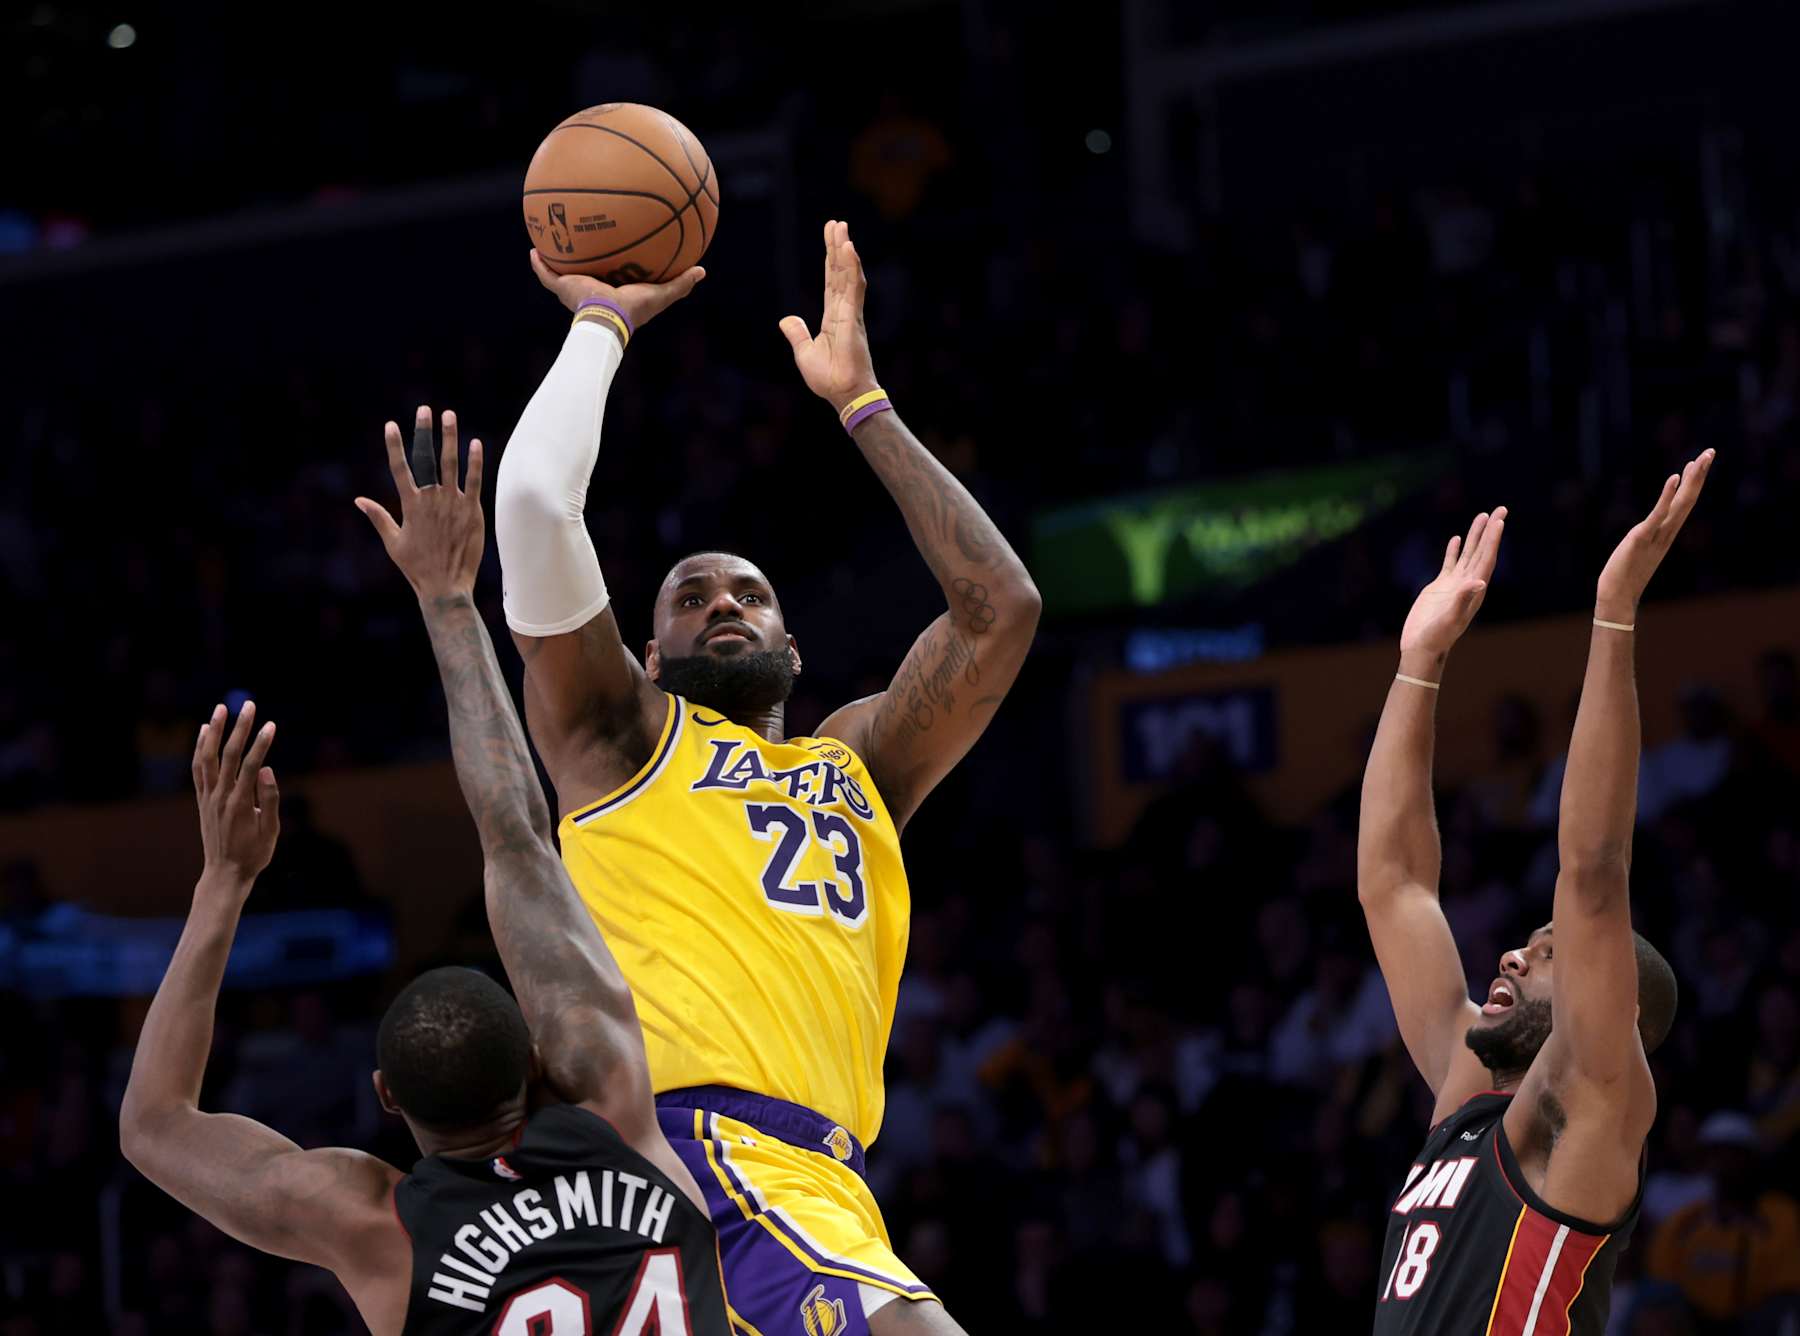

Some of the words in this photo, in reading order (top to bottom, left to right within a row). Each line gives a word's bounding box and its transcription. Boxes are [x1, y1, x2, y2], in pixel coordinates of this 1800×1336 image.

[689, 739, 876, 822] LAERS
[744, 800, 869, 930] 23
[427, 1170, 676, 1313] HIGHSMITH
